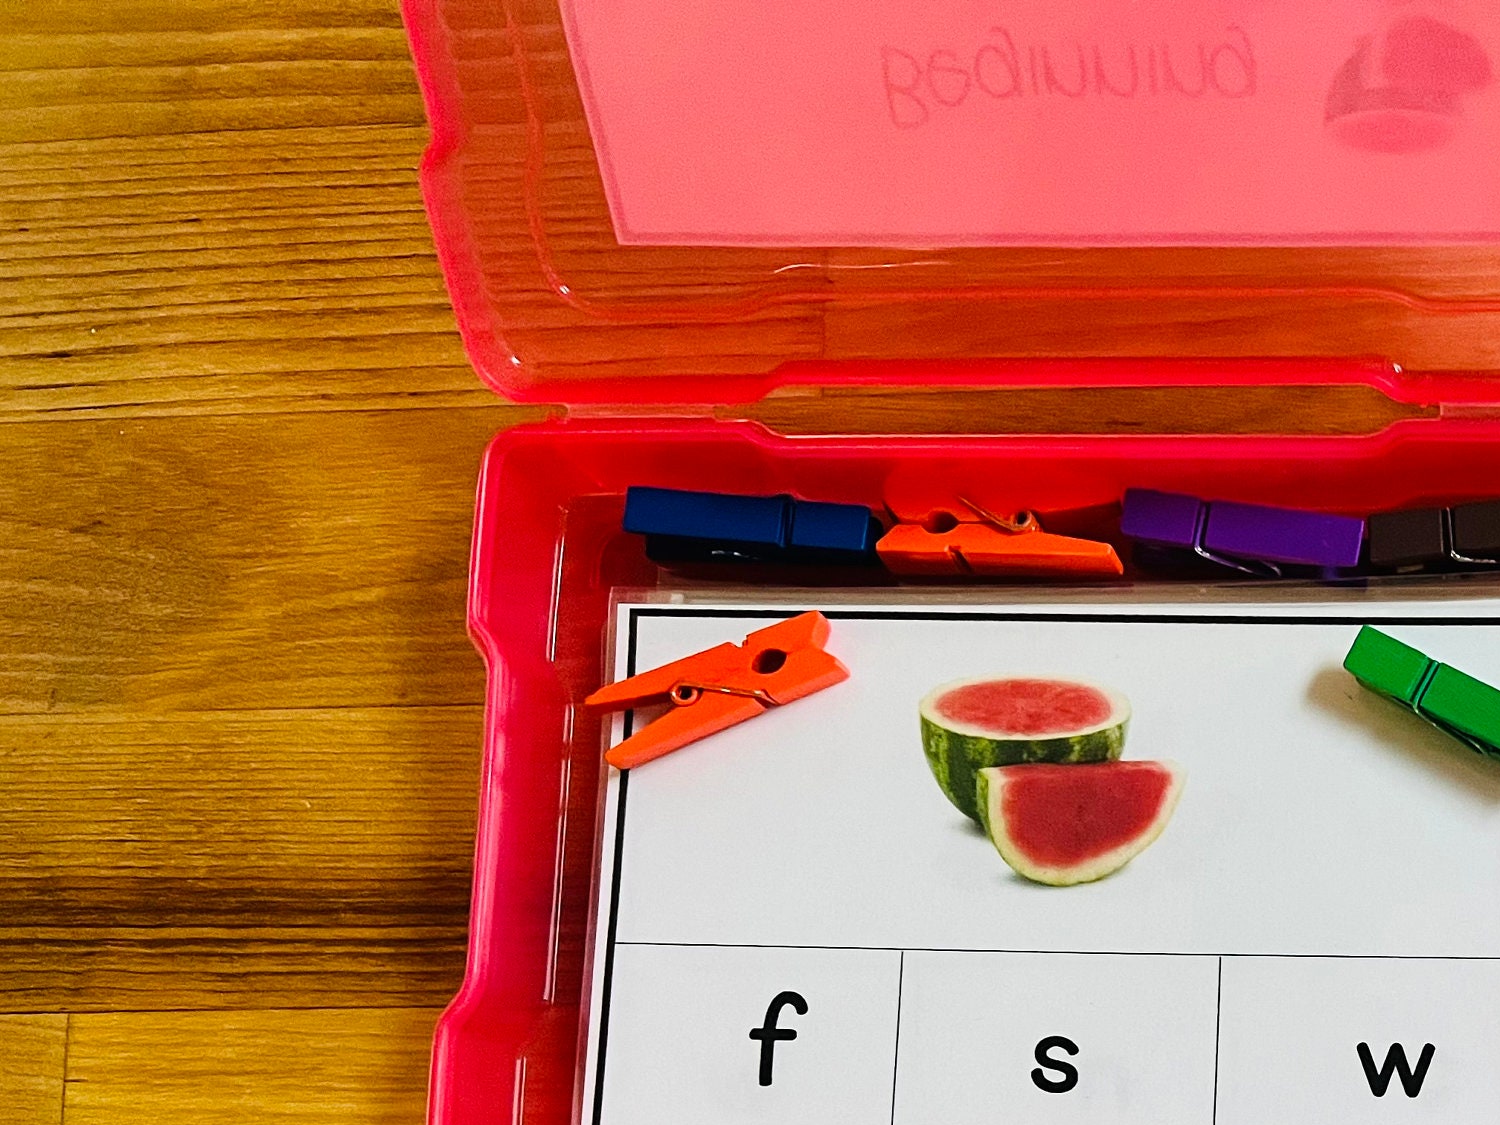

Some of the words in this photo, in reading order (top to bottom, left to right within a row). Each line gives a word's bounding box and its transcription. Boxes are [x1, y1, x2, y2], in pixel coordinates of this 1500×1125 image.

[749, 991, 808, 1086] f
[1031, 1036, 1079, 1093] s
[1357, 1042, 1435, 1097] w
